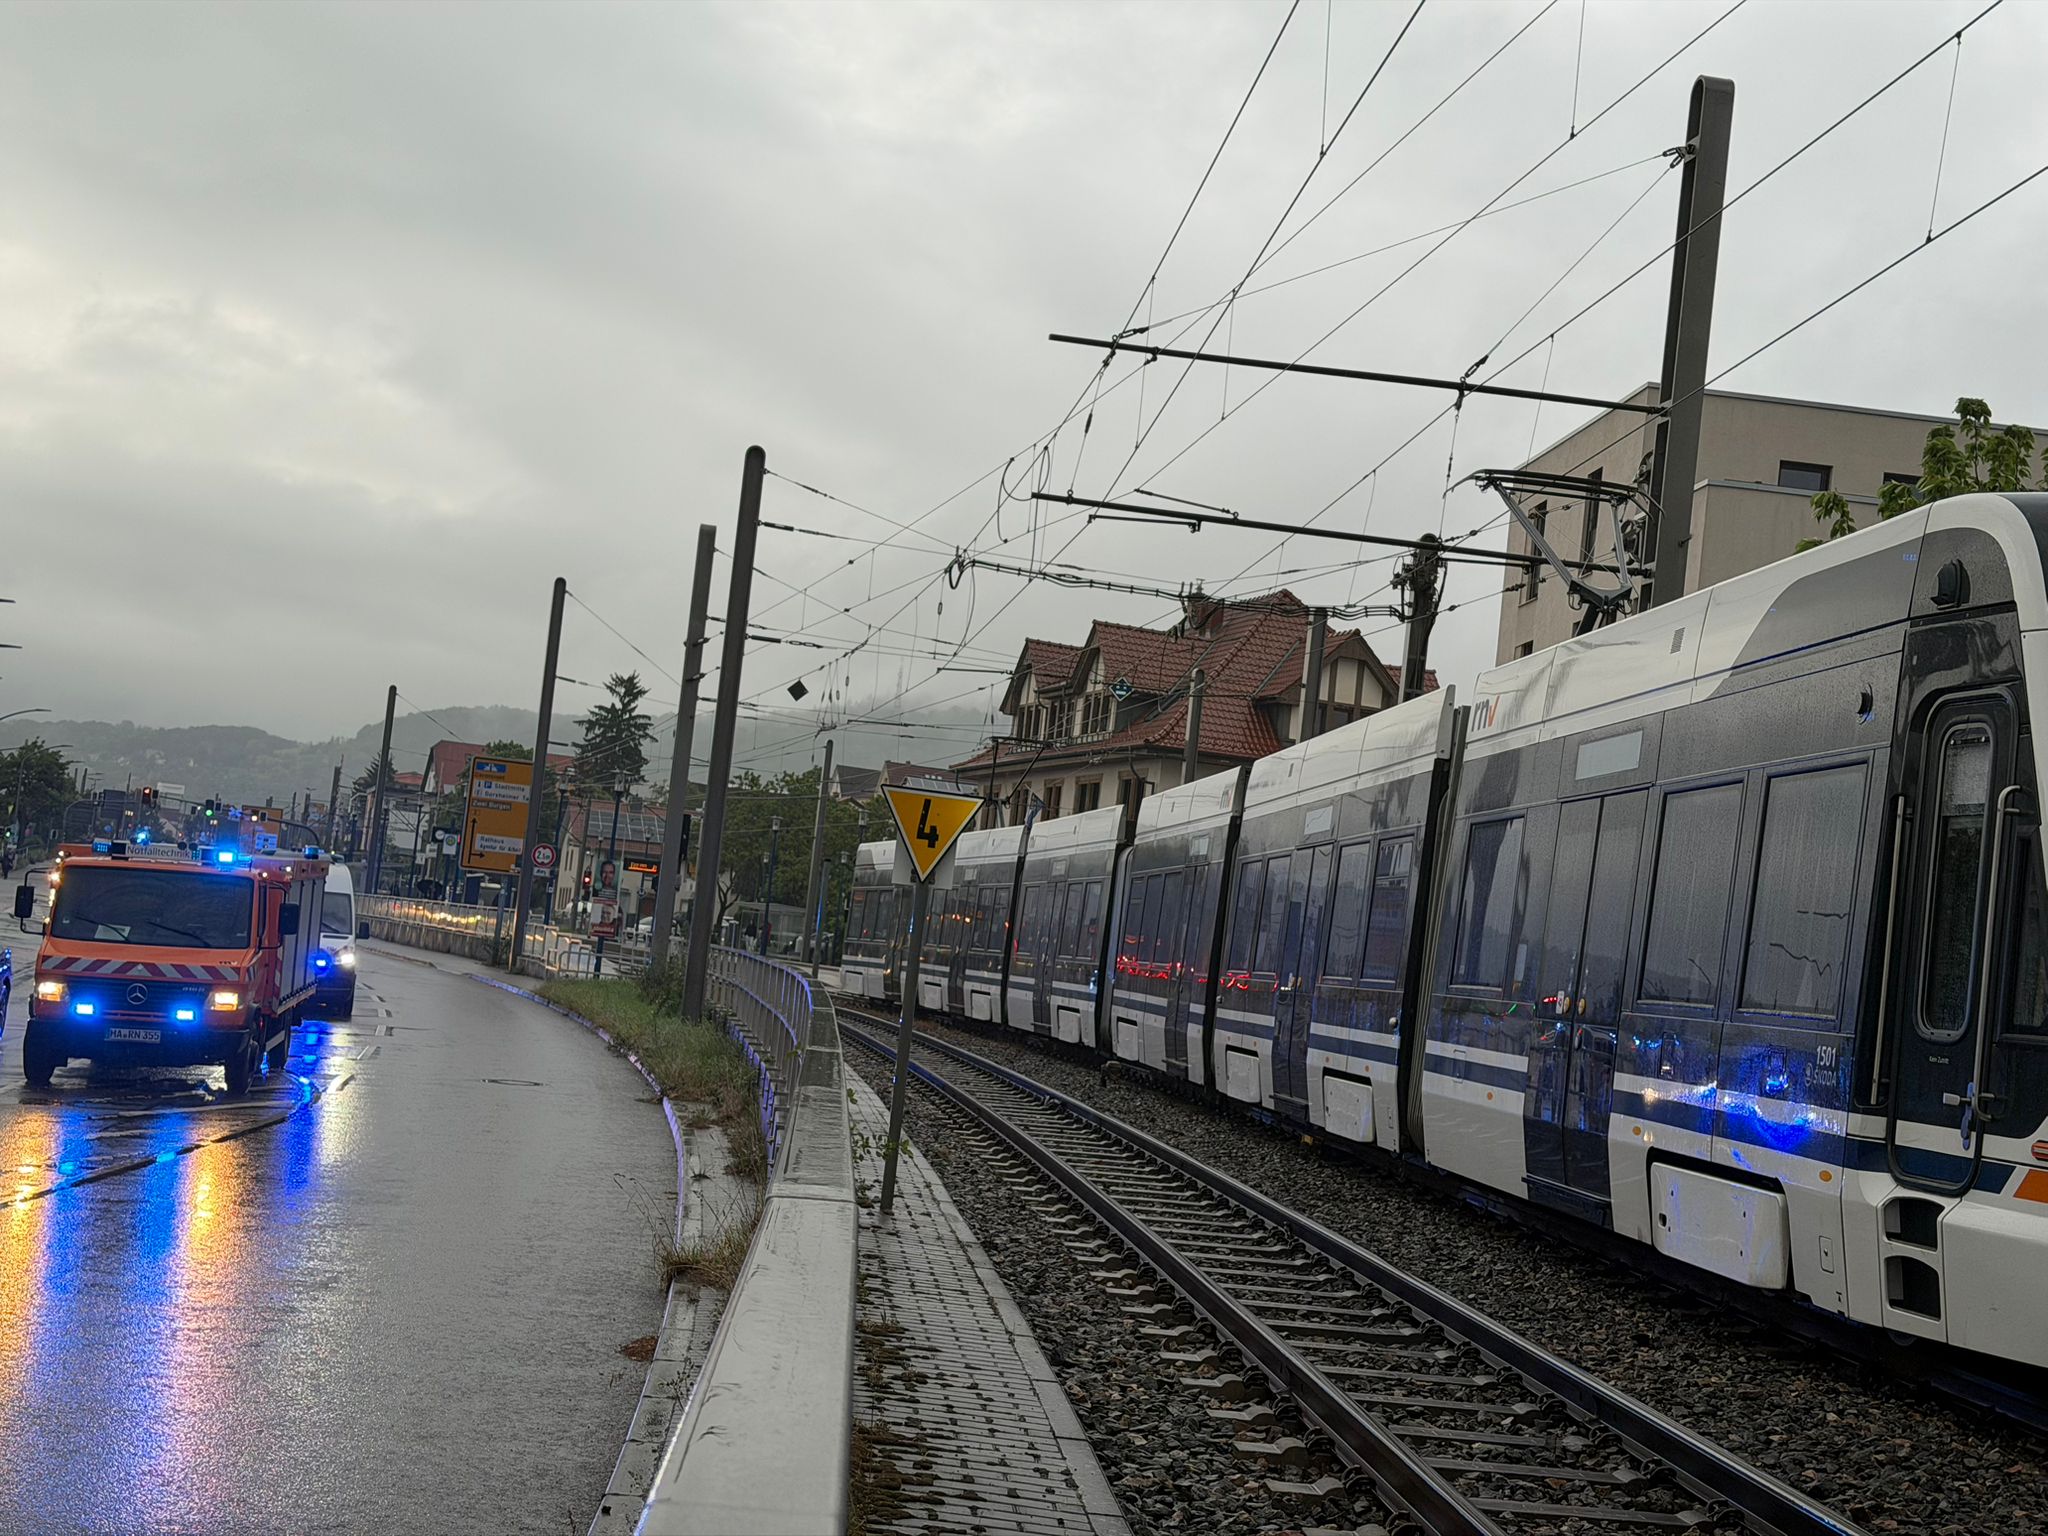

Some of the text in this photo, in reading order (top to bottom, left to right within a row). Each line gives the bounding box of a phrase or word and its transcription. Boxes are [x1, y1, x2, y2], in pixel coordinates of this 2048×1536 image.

[1471, 694, 1500, 732] rnv
[917, 799, 939, 848] 4
[128, 845, 190, 857] Notfalltechnik
[110, 1029, 160, 1040] HA RN 355
[1816, 1045, 1837, 1068] 1501
